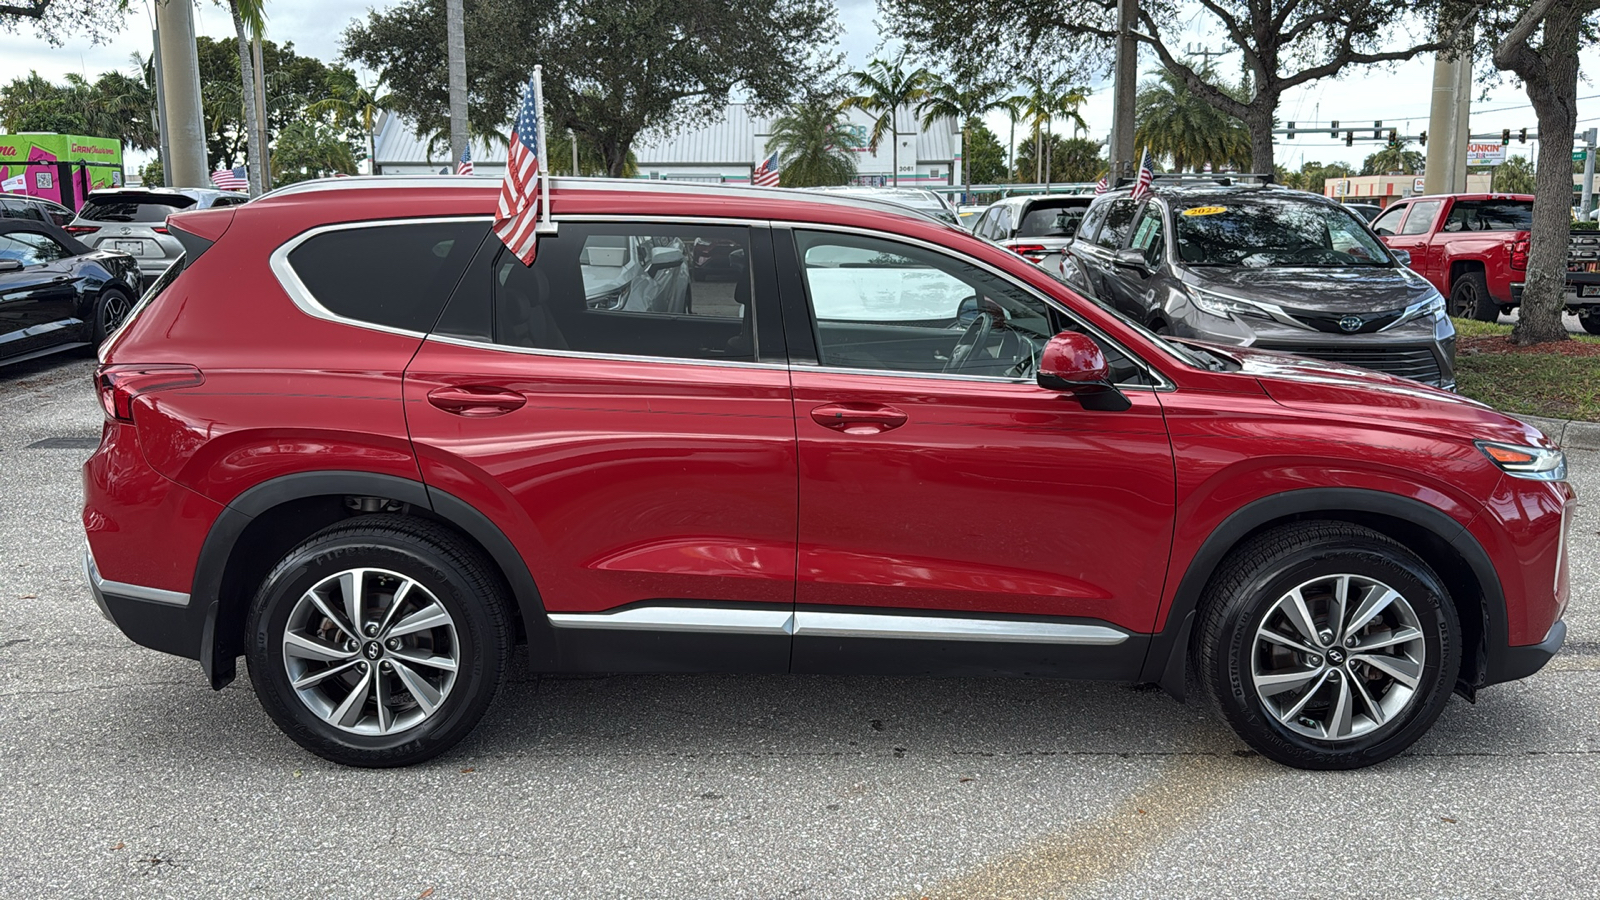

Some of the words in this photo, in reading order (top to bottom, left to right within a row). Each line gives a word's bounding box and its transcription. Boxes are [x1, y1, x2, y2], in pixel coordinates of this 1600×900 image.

[1190, 207, 1219, 215] 2022
[1229, 624, 1246, 697] DESTINATION
[1435, 622, 1450, 695] DESTINATION
